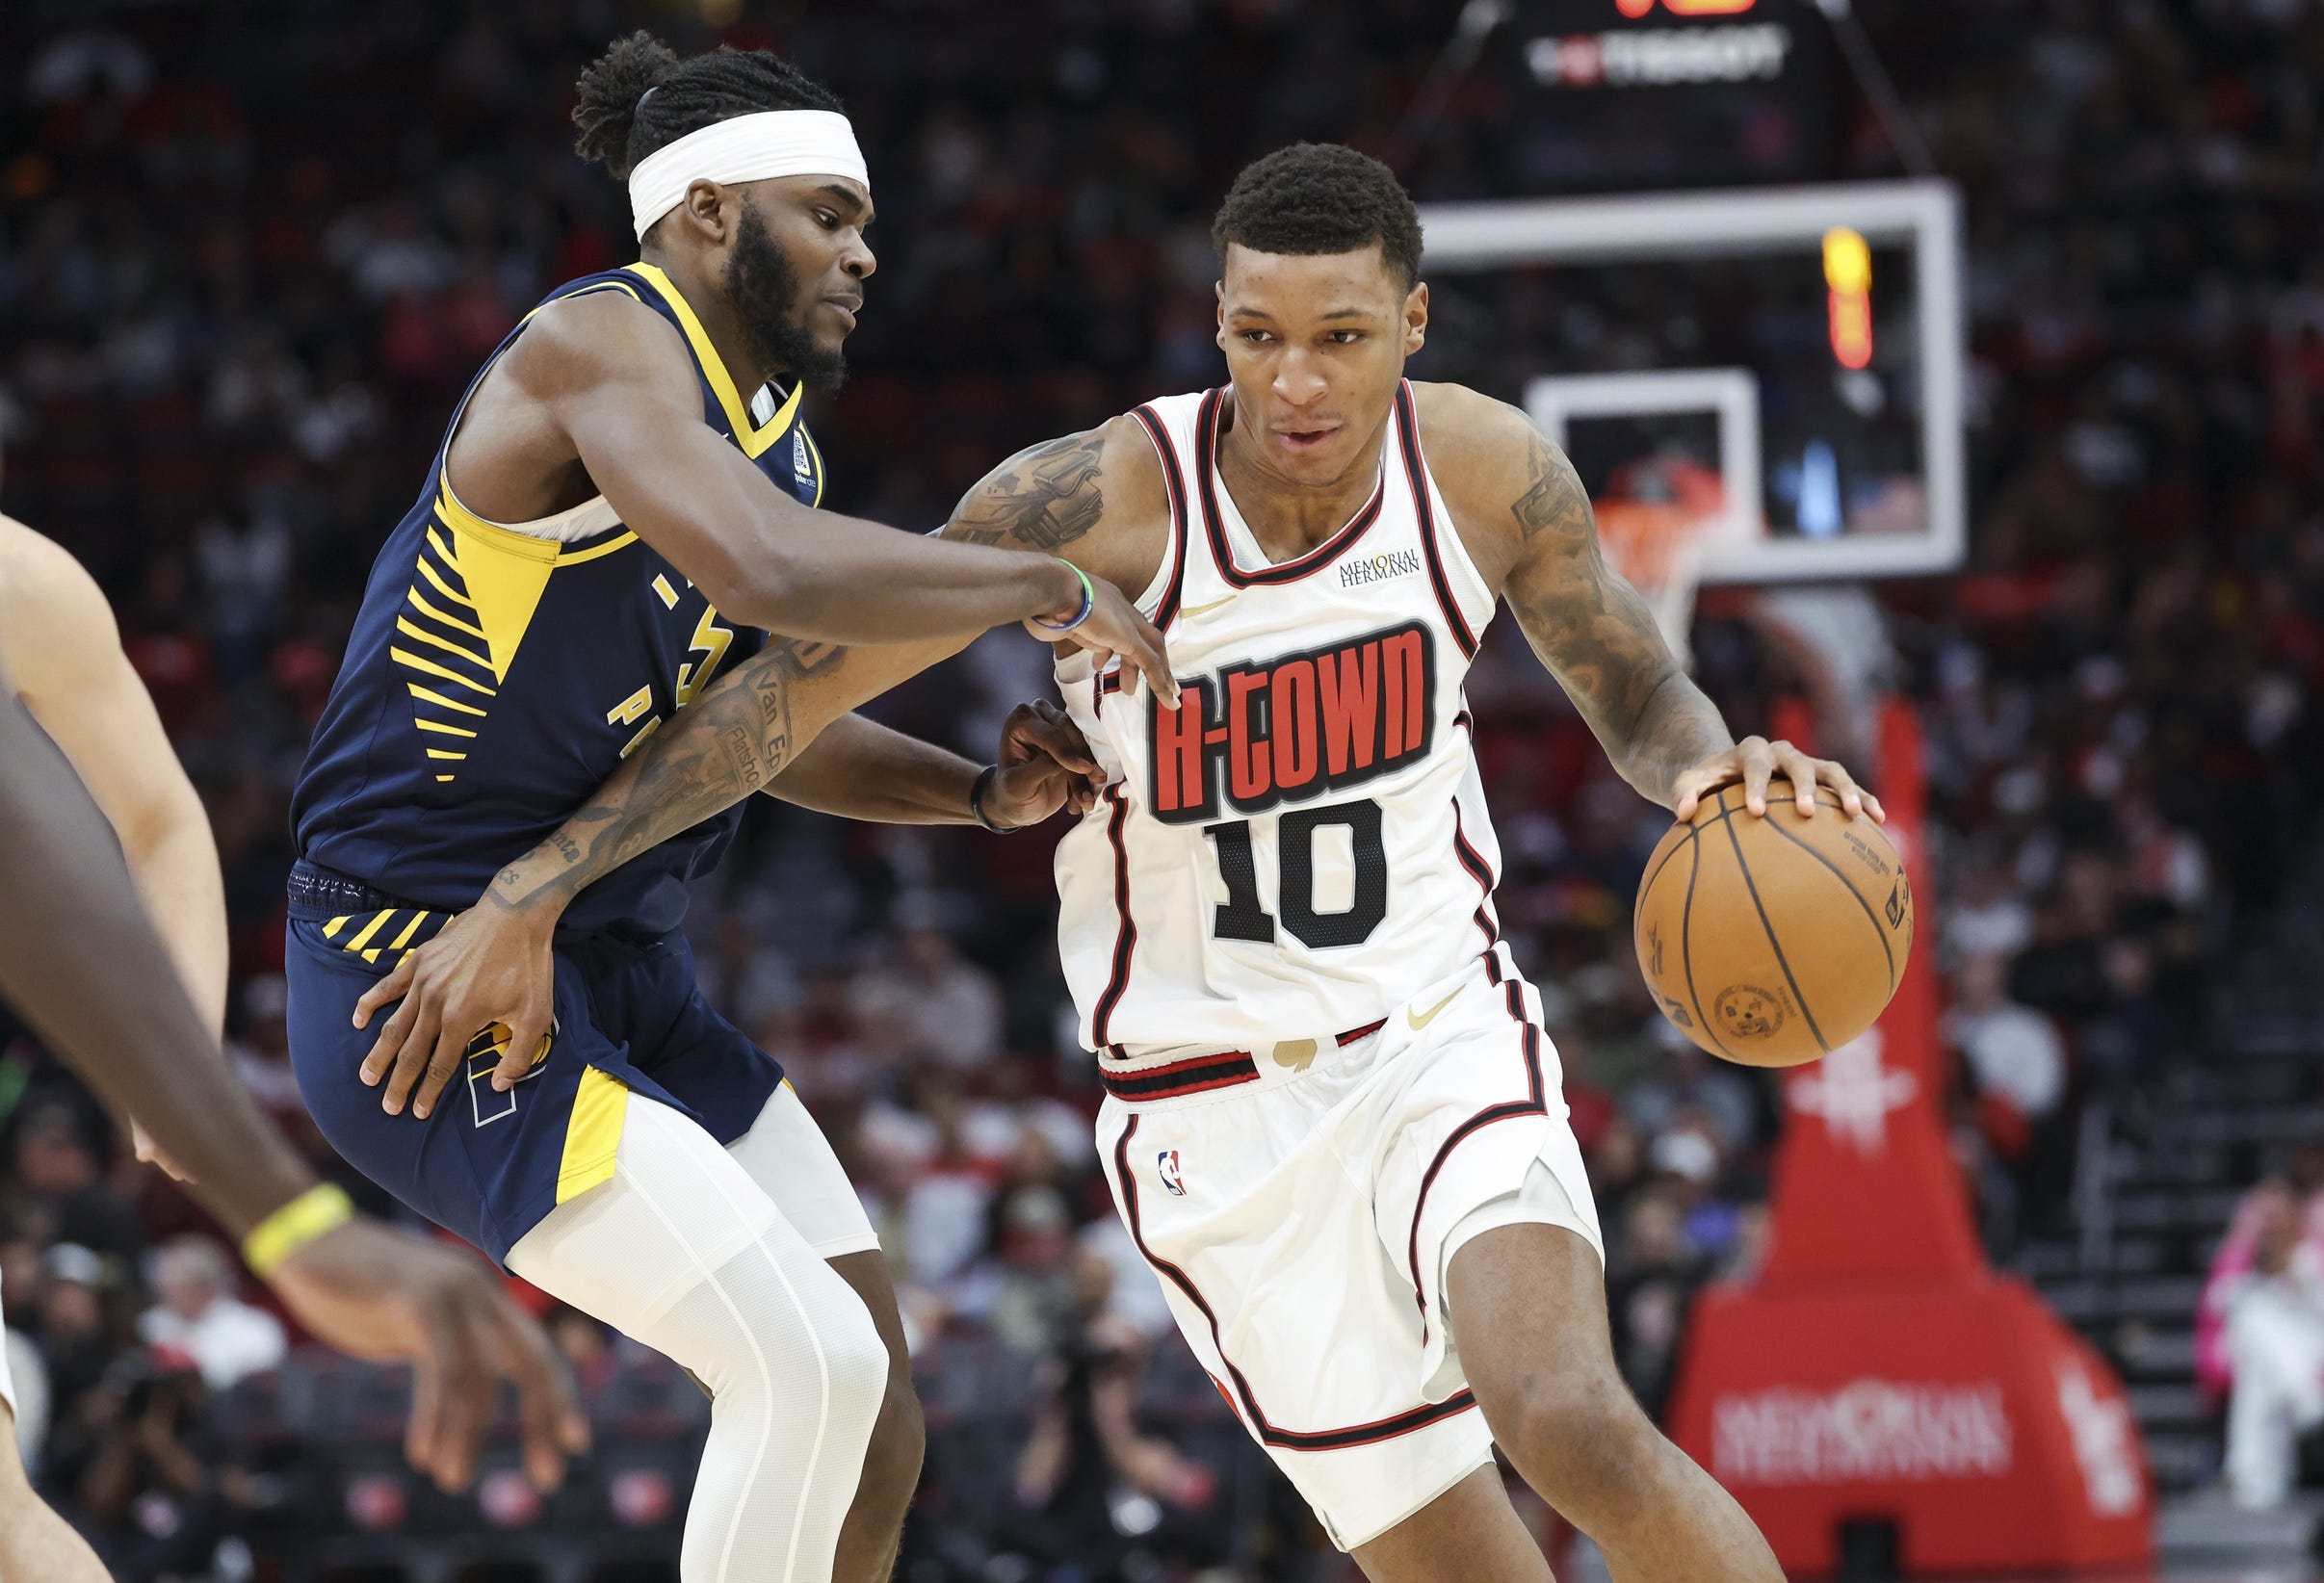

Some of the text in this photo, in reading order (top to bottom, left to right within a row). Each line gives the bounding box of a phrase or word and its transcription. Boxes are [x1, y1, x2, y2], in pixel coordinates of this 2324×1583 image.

[1339, 548, 1420, 578] MEMORIAL
[1341, 558, 1420, 587] HERMANN
[1204, 797, 1389, 949] 10
